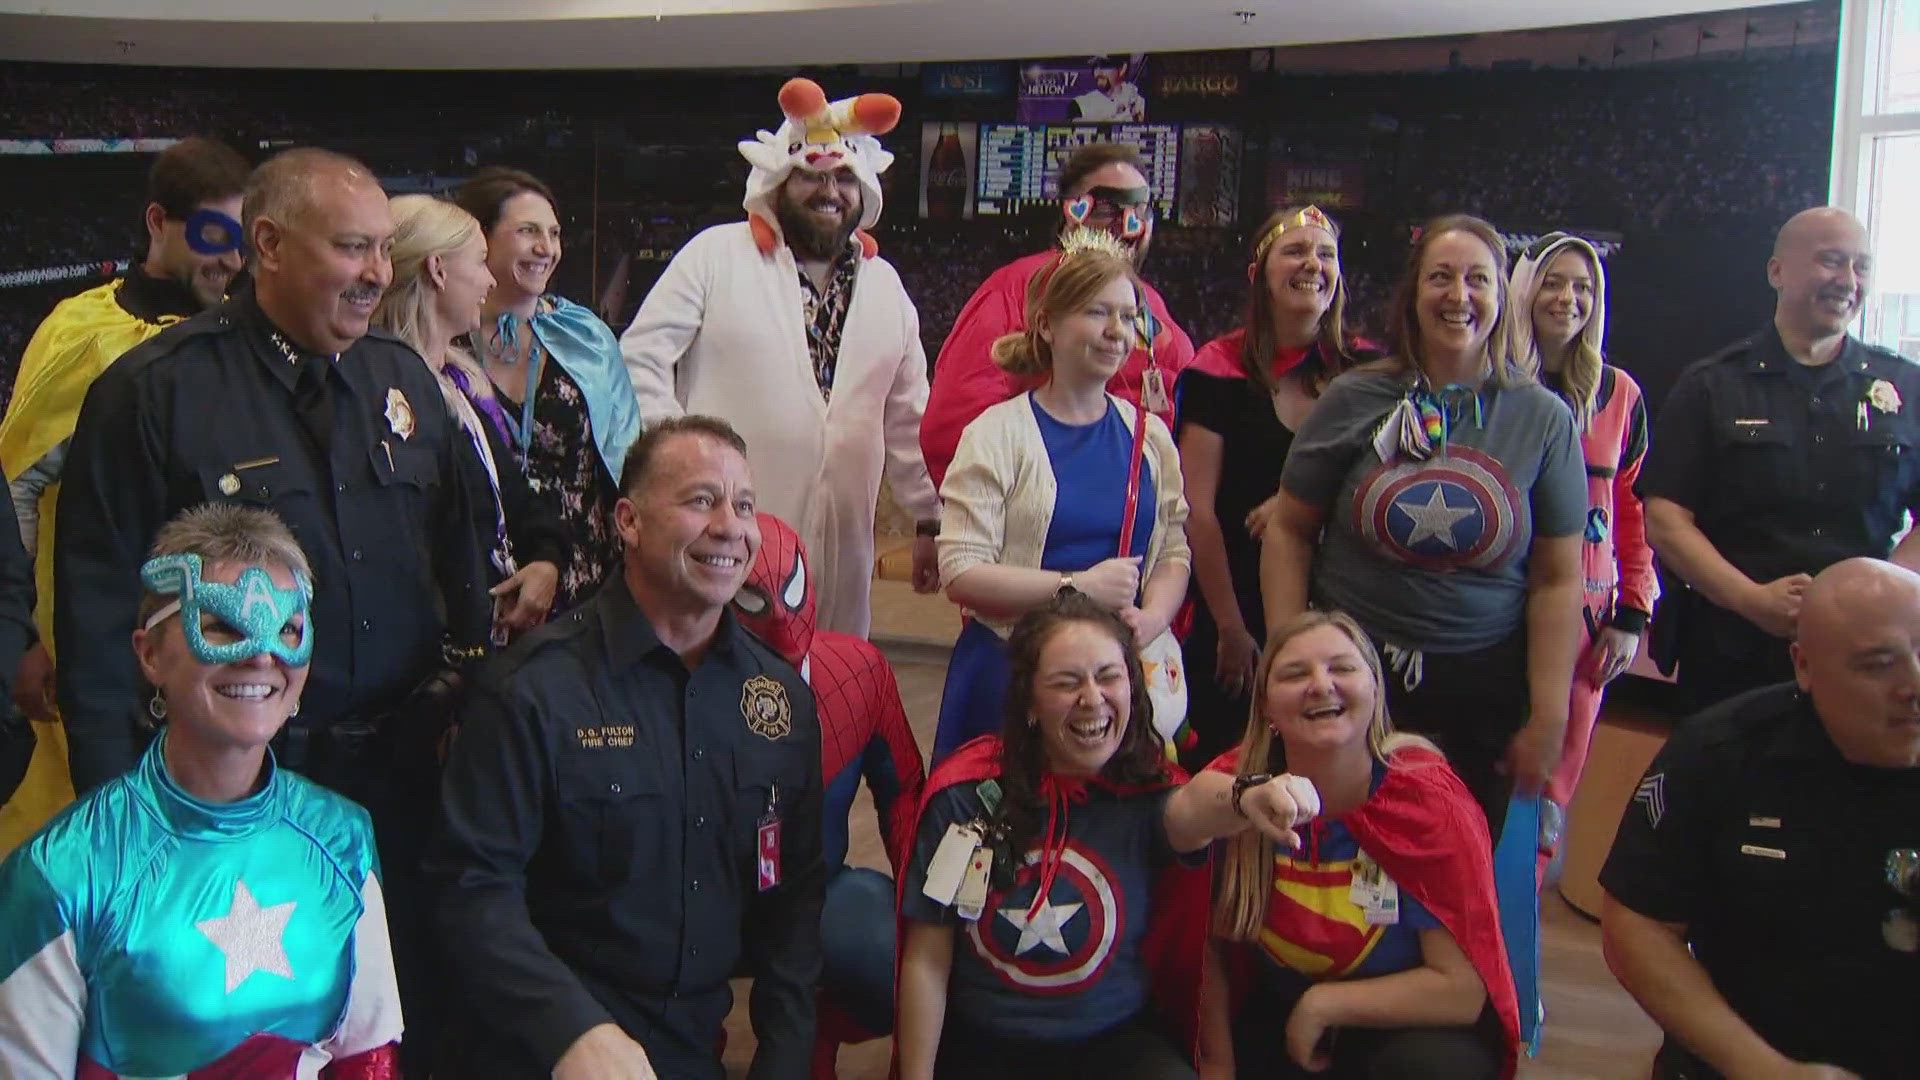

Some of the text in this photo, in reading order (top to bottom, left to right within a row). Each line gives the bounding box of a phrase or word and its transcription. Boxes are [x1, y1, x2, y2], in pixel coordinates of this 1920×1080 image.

[1064, 71, 1078, 87] 17
[1028, 84, 1065, 95] HELTON
[601, 725, 635, 737] FULTON
[582, 736, 635, 748] FIRE CHIEF
